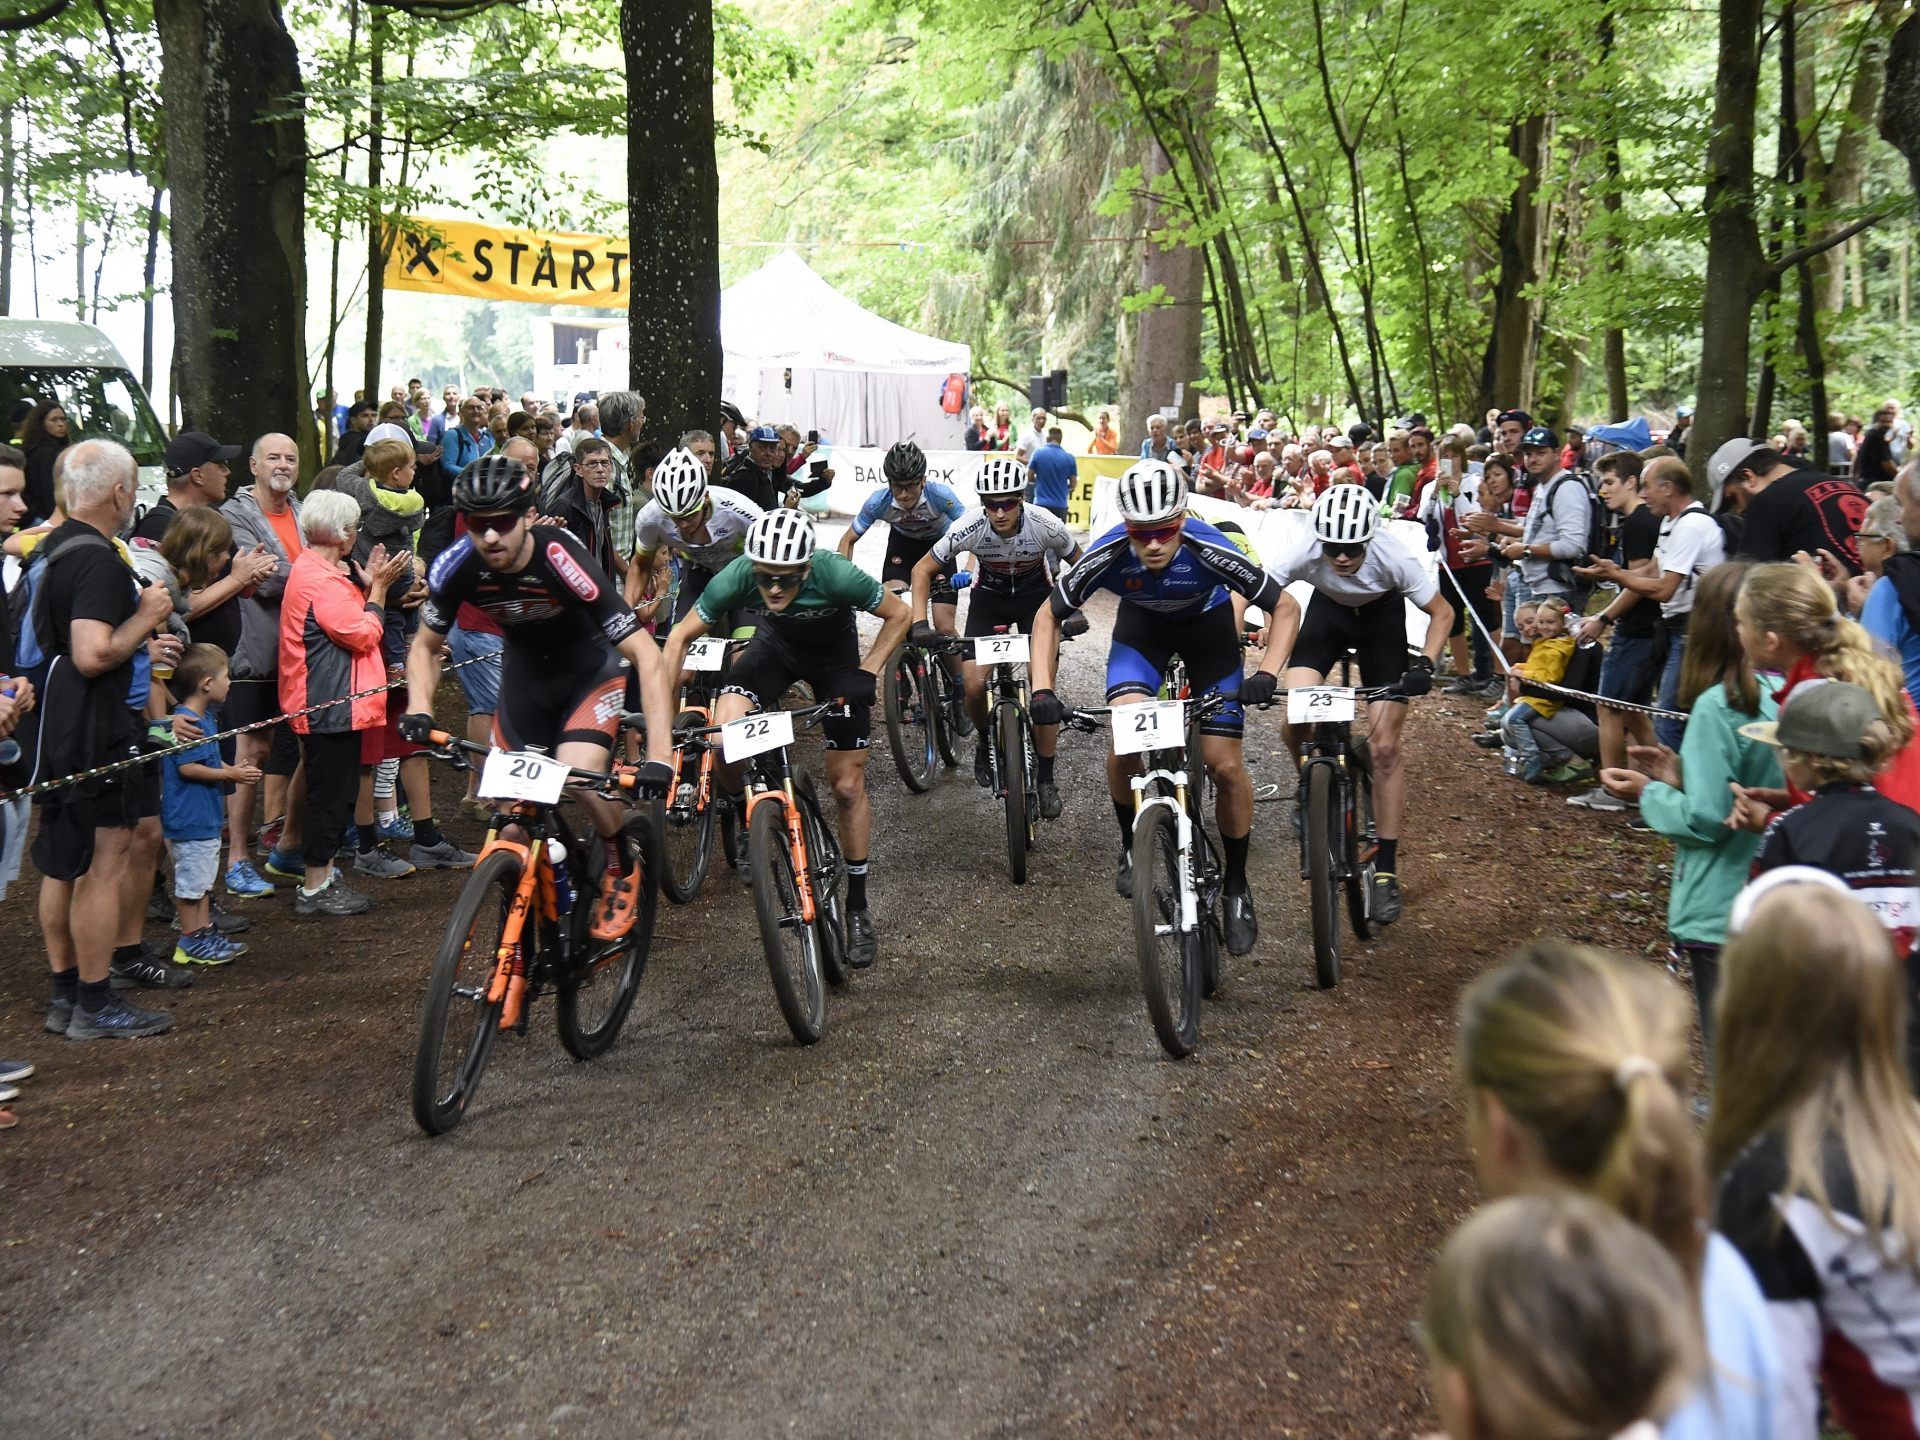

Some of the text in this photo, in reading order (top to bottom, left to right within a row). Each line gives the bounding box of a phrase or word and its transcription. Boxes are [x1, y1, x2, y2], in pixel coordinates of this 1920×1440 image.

[473, 238, 629, 293] START
[552, 551, 593, 596] ABUS
[688, 643, 708, 656] 24
[992, 640, 1011, 652] 27
[1309, 693, 1333, 707] 23
[744, 720, 770, 740] 22
[1134, 711, 1158, 732] 21
[508, 758, 542, 781] 20
